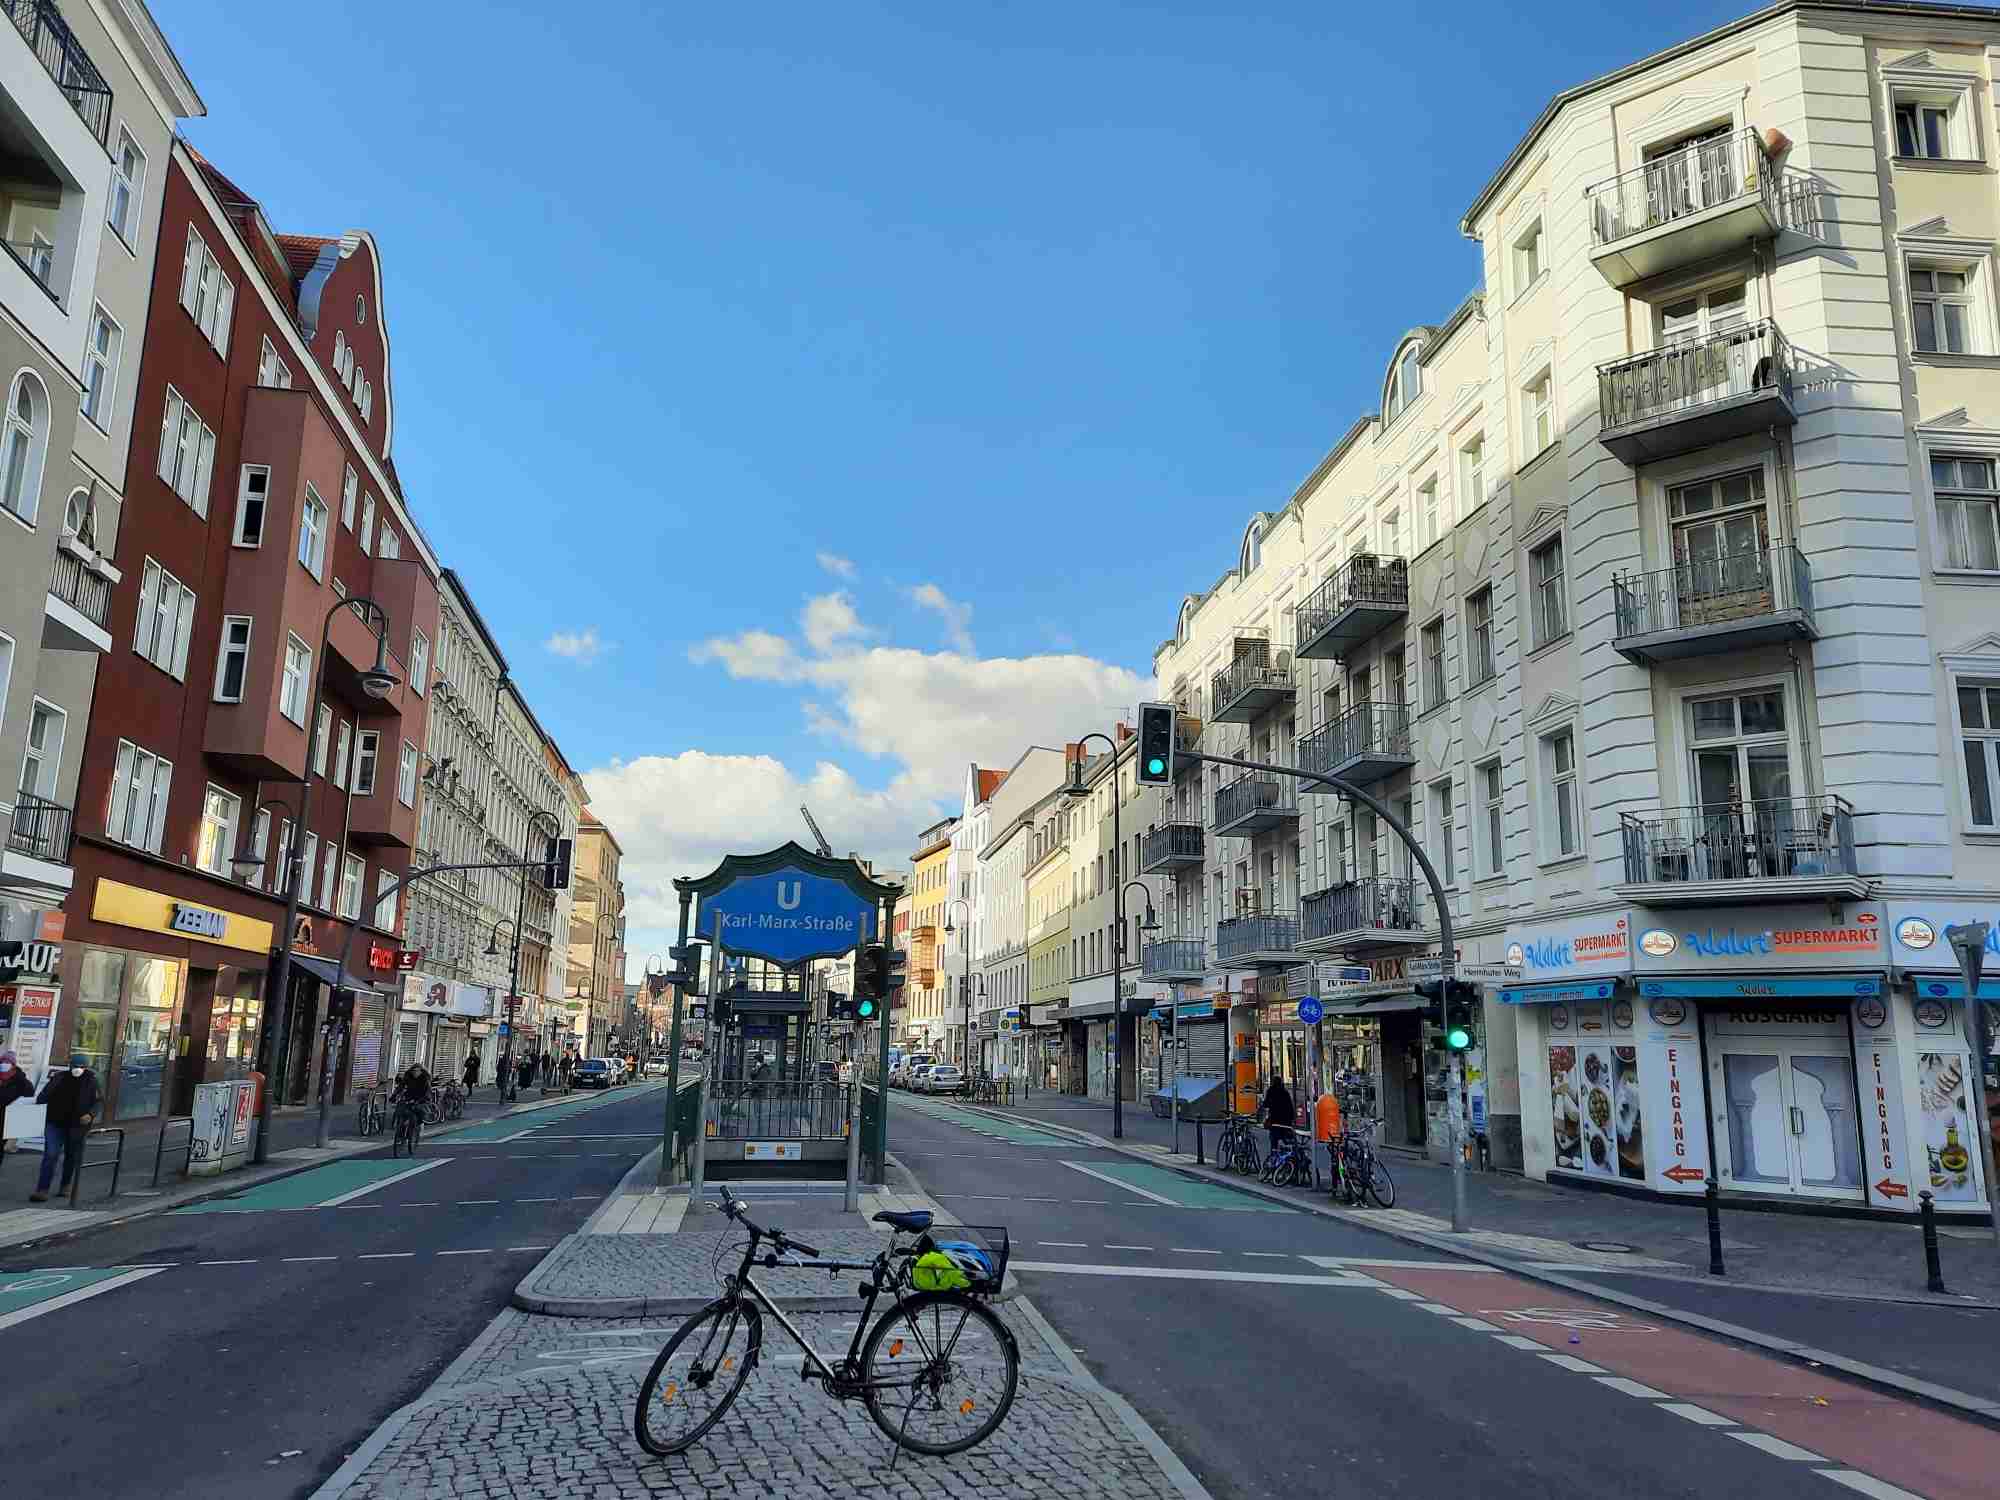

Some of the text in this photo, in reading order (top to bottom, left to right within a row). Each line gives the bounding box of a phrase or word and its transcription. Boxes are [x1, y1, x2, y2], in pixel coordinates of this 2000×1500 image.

[777, 880, 801, 911] U
[721, 912, 853, 932] Karl-Marx-Straße
[1574, 933, 1627, 951] SUPERMARKT
[1775, 928, 1879, 945] SUPERMARKT
[1504, 967, 1521, 979] Weg
[1728, 1008, 1840, 1024] AUSGANG
[1667, 1049, 1685, 1156] EINGANG
[1873, 1053, 1892, 1169] EINGANG
